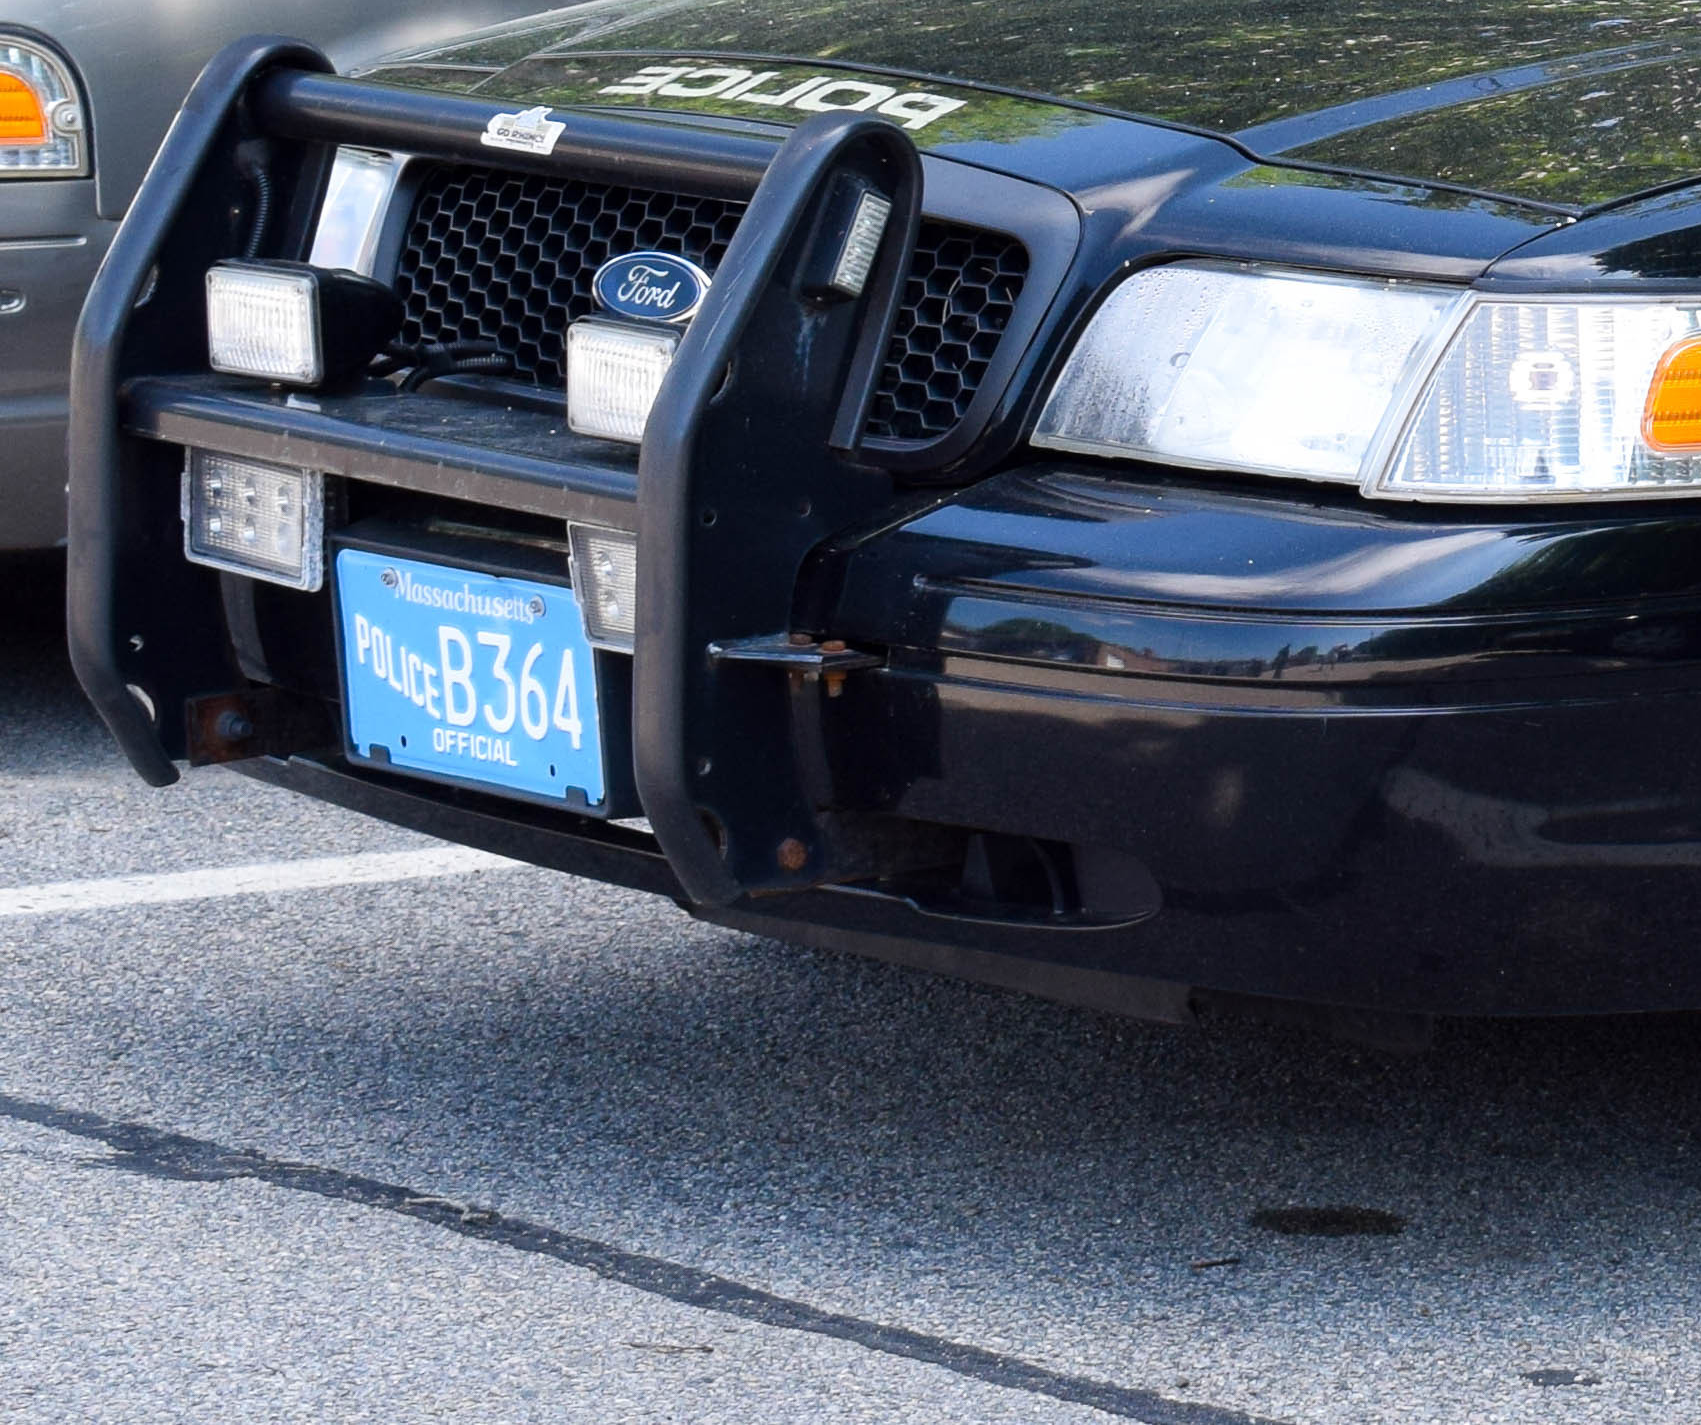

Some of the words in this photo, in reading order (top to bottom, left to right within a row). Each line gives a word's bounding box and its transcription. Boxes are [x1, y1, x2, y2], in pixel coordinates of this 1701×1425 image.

[617, 264, 681, 310] Ford
[394, 572, 535, 624] Massachusetts
[354, 613, 441, 720] POLICE
[438, 625, 583, 750] B364
[432, 727, 518, 767] OFFICIAL
